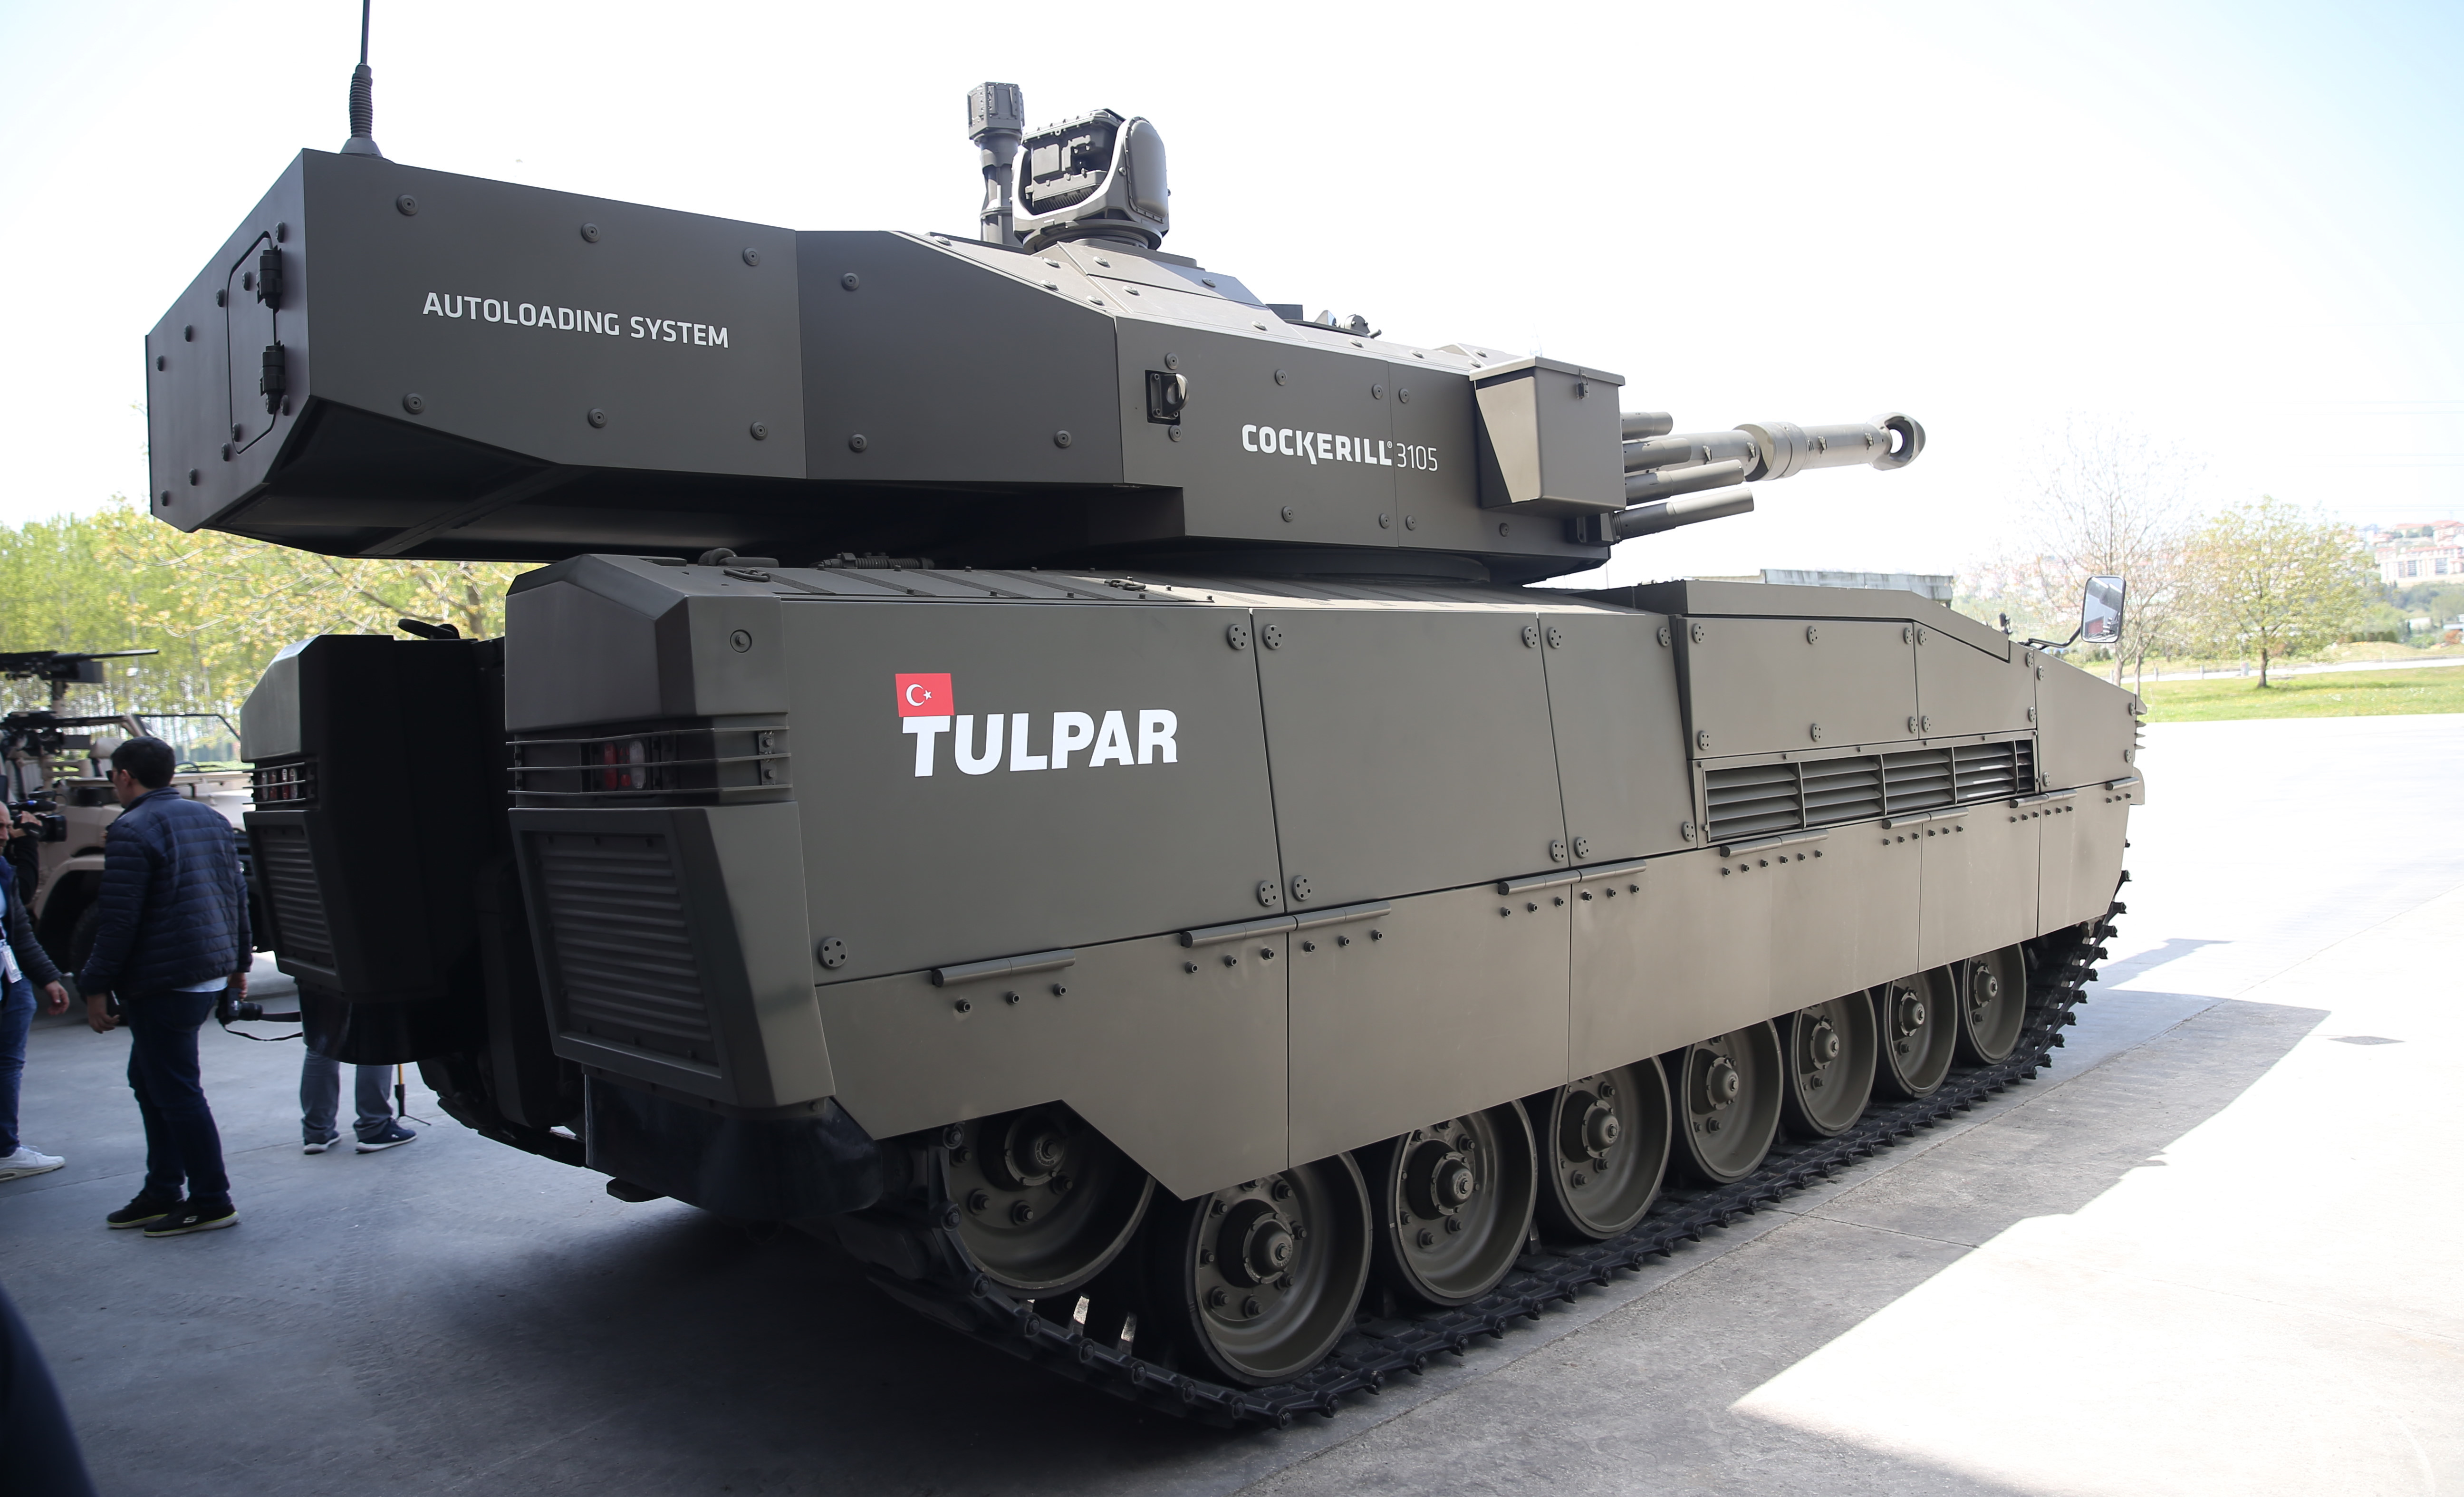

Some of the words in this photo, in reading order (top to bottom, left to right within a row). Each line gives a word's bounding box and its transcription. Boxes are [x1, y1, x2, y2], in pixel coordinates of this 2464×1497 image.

[423, 292, 619, 335] AUTOLOADING
[630, 316, 729, 348] SYSTEM
[1396, 443, 1438, 472] 3105
[902, 709, 1178, 777] TULPAR
